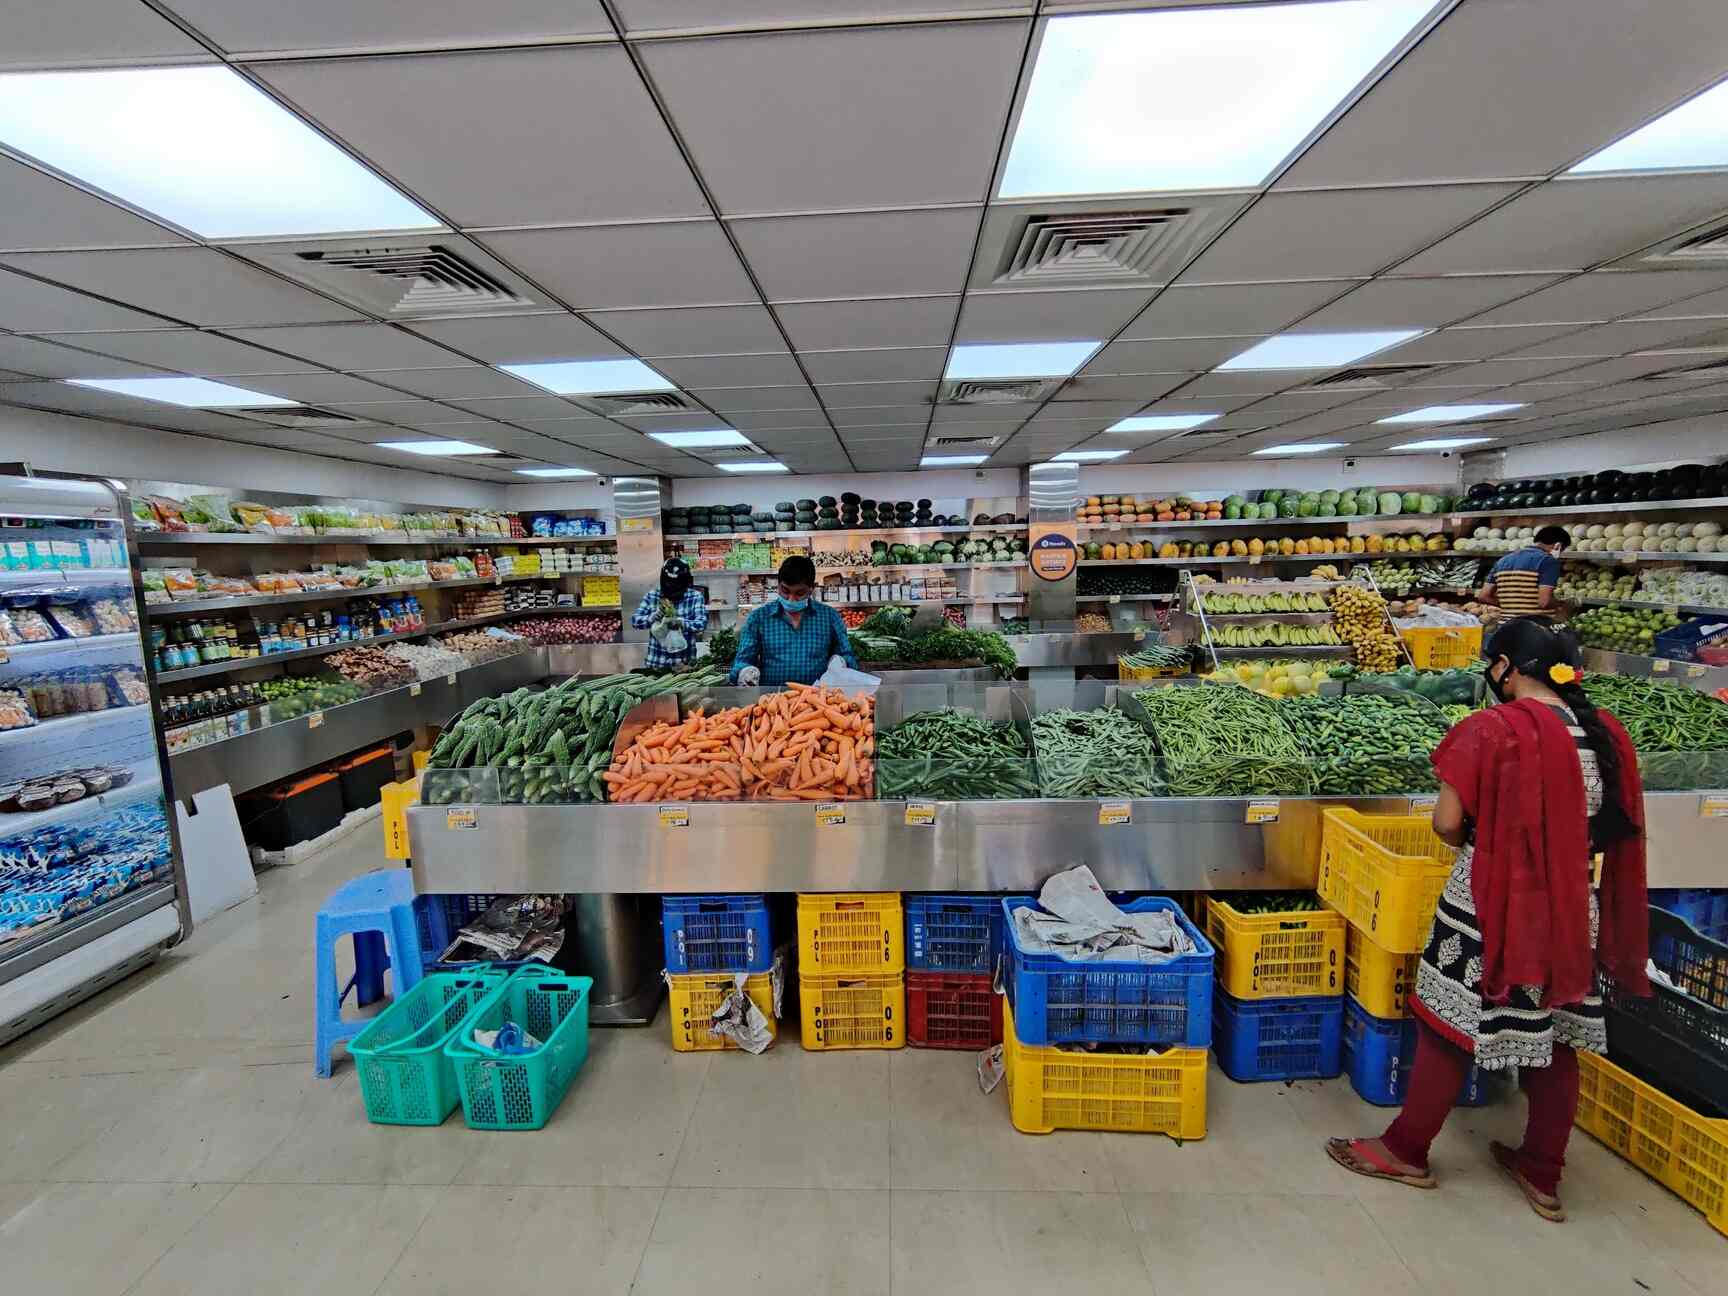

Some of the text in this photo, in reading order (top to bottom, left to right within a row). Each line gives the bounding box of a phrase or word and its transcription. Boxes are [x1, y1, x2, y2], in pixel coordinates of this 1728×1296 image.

[747, 928, 754, 961] 09
[884, 929, 890, 962] 06
[1252, 951, 1260, 991] POL
[1329, 949, 1336, 988] 06
[683, 1007, 691, 1042] POL
[815, 1006, 823, 1042] POL
[885, 1006, 893, 1041] 06
